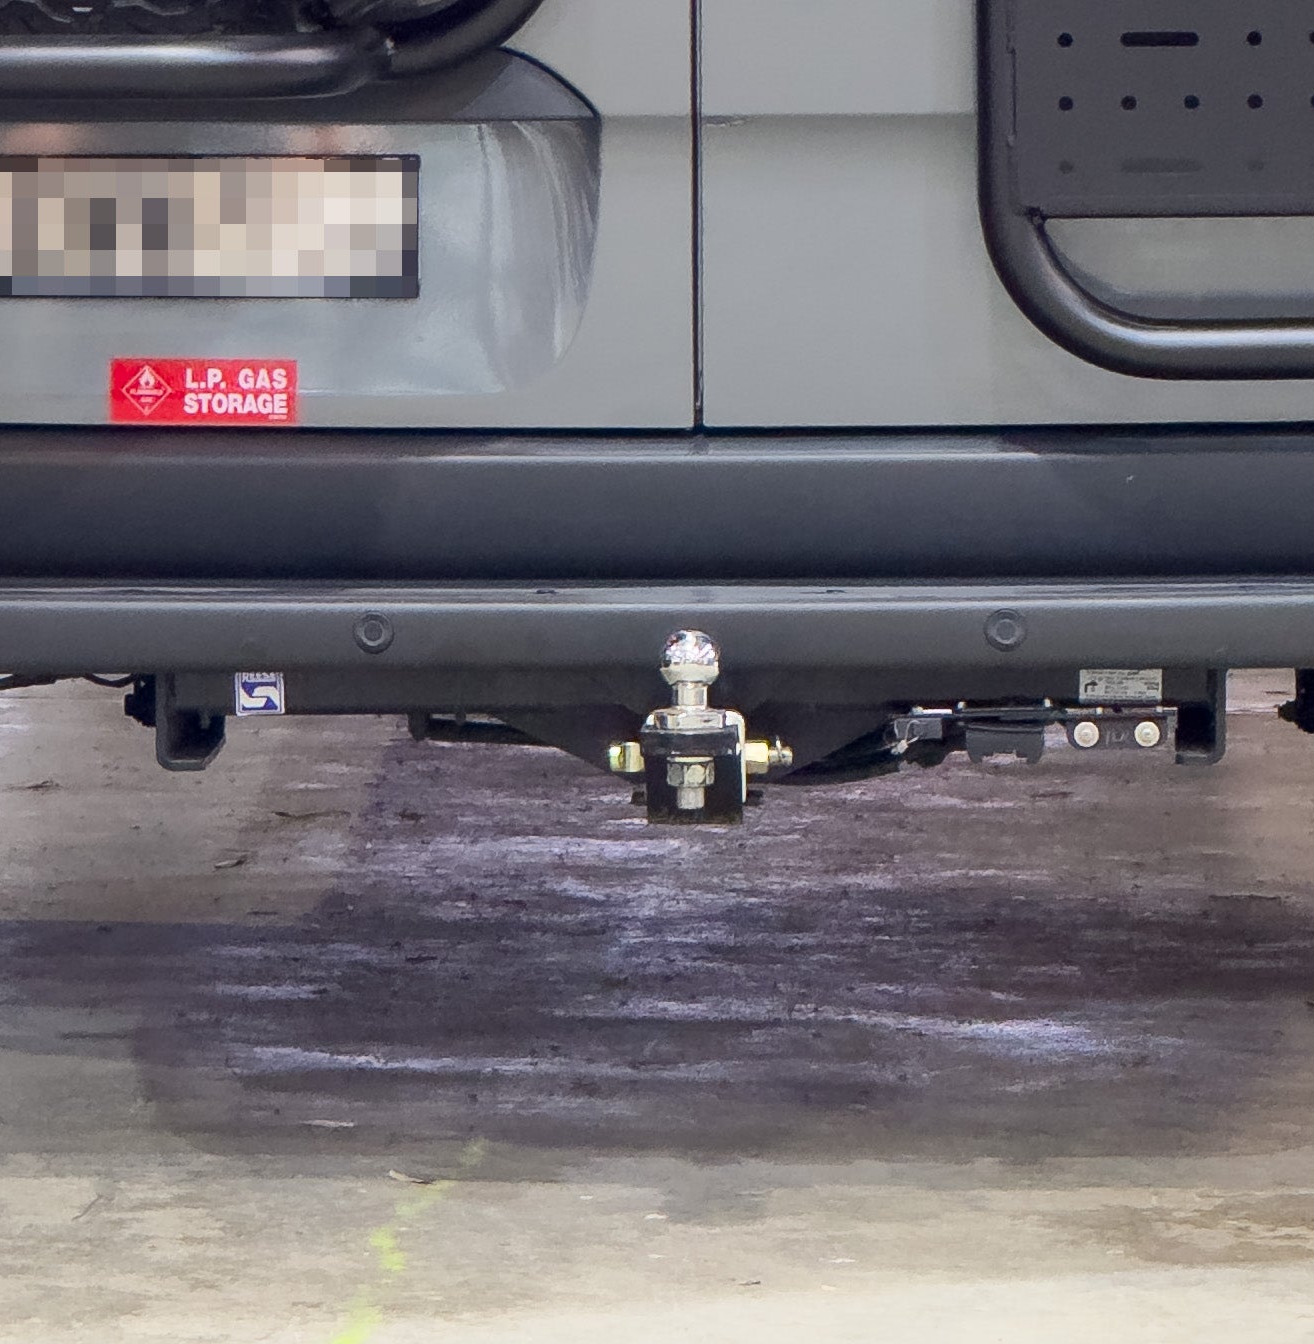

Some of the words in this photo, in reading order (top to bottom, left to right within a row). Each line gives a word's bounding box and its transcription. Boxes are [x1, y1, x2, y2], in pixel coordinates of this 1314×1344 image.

[186, 368, 226, 389] L.P.
[238, 368, 288, 390] GAS
[183, 393, 288, 414] STORAGE
